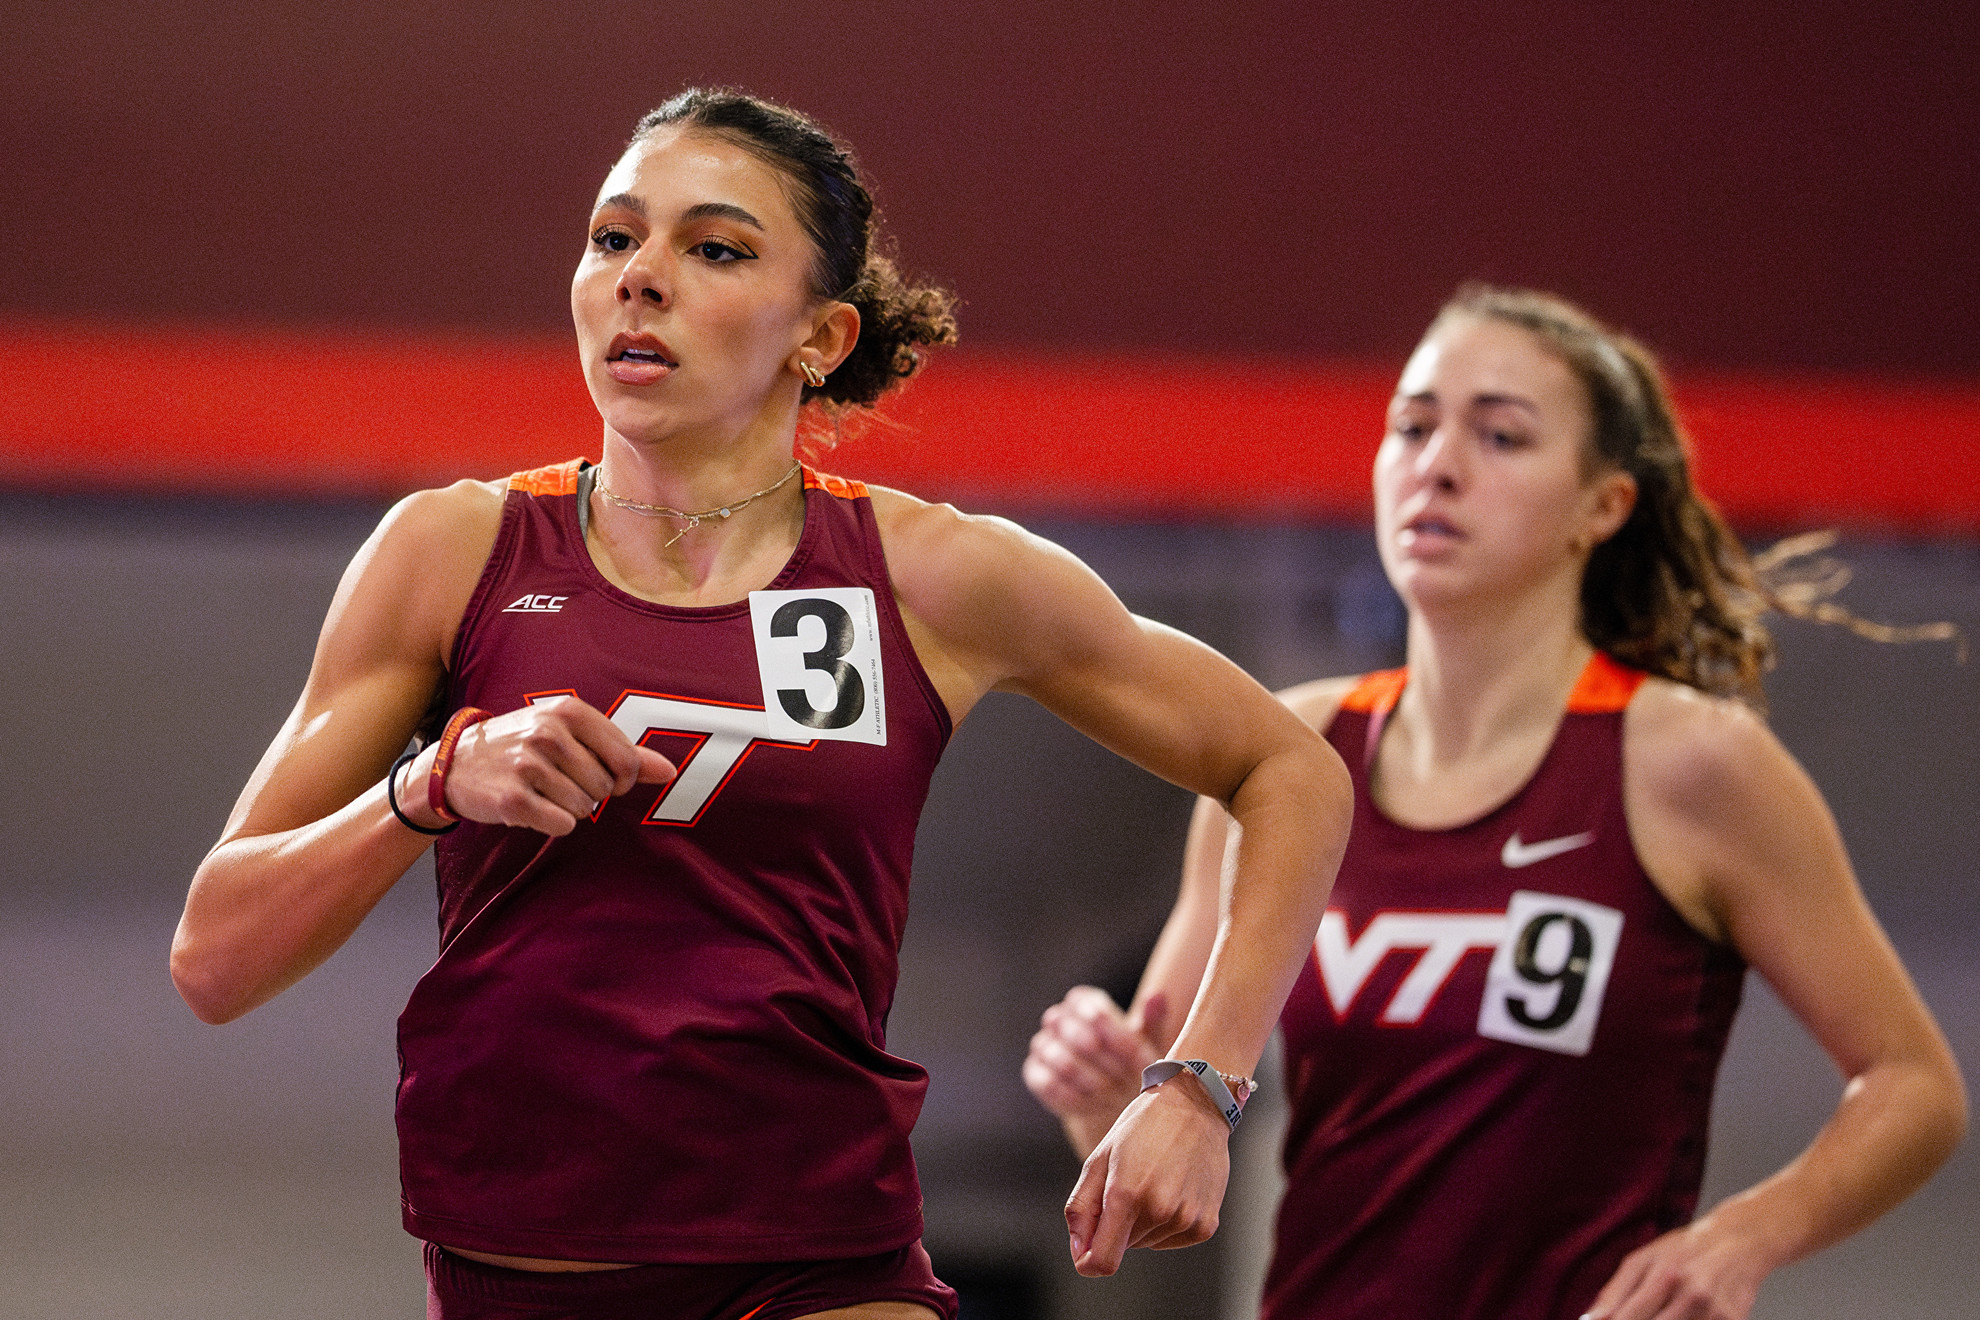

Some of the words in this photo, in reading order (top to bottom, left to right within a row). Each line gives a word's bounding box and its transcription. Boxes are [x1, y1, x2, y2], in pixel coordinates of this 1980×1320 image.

[508, 594, 569, 610] ACC
[770, 598, 865, 729] 3
[1312, 906, 1507, 1028] VT
[1505, 912, 1594, 1031] 9
